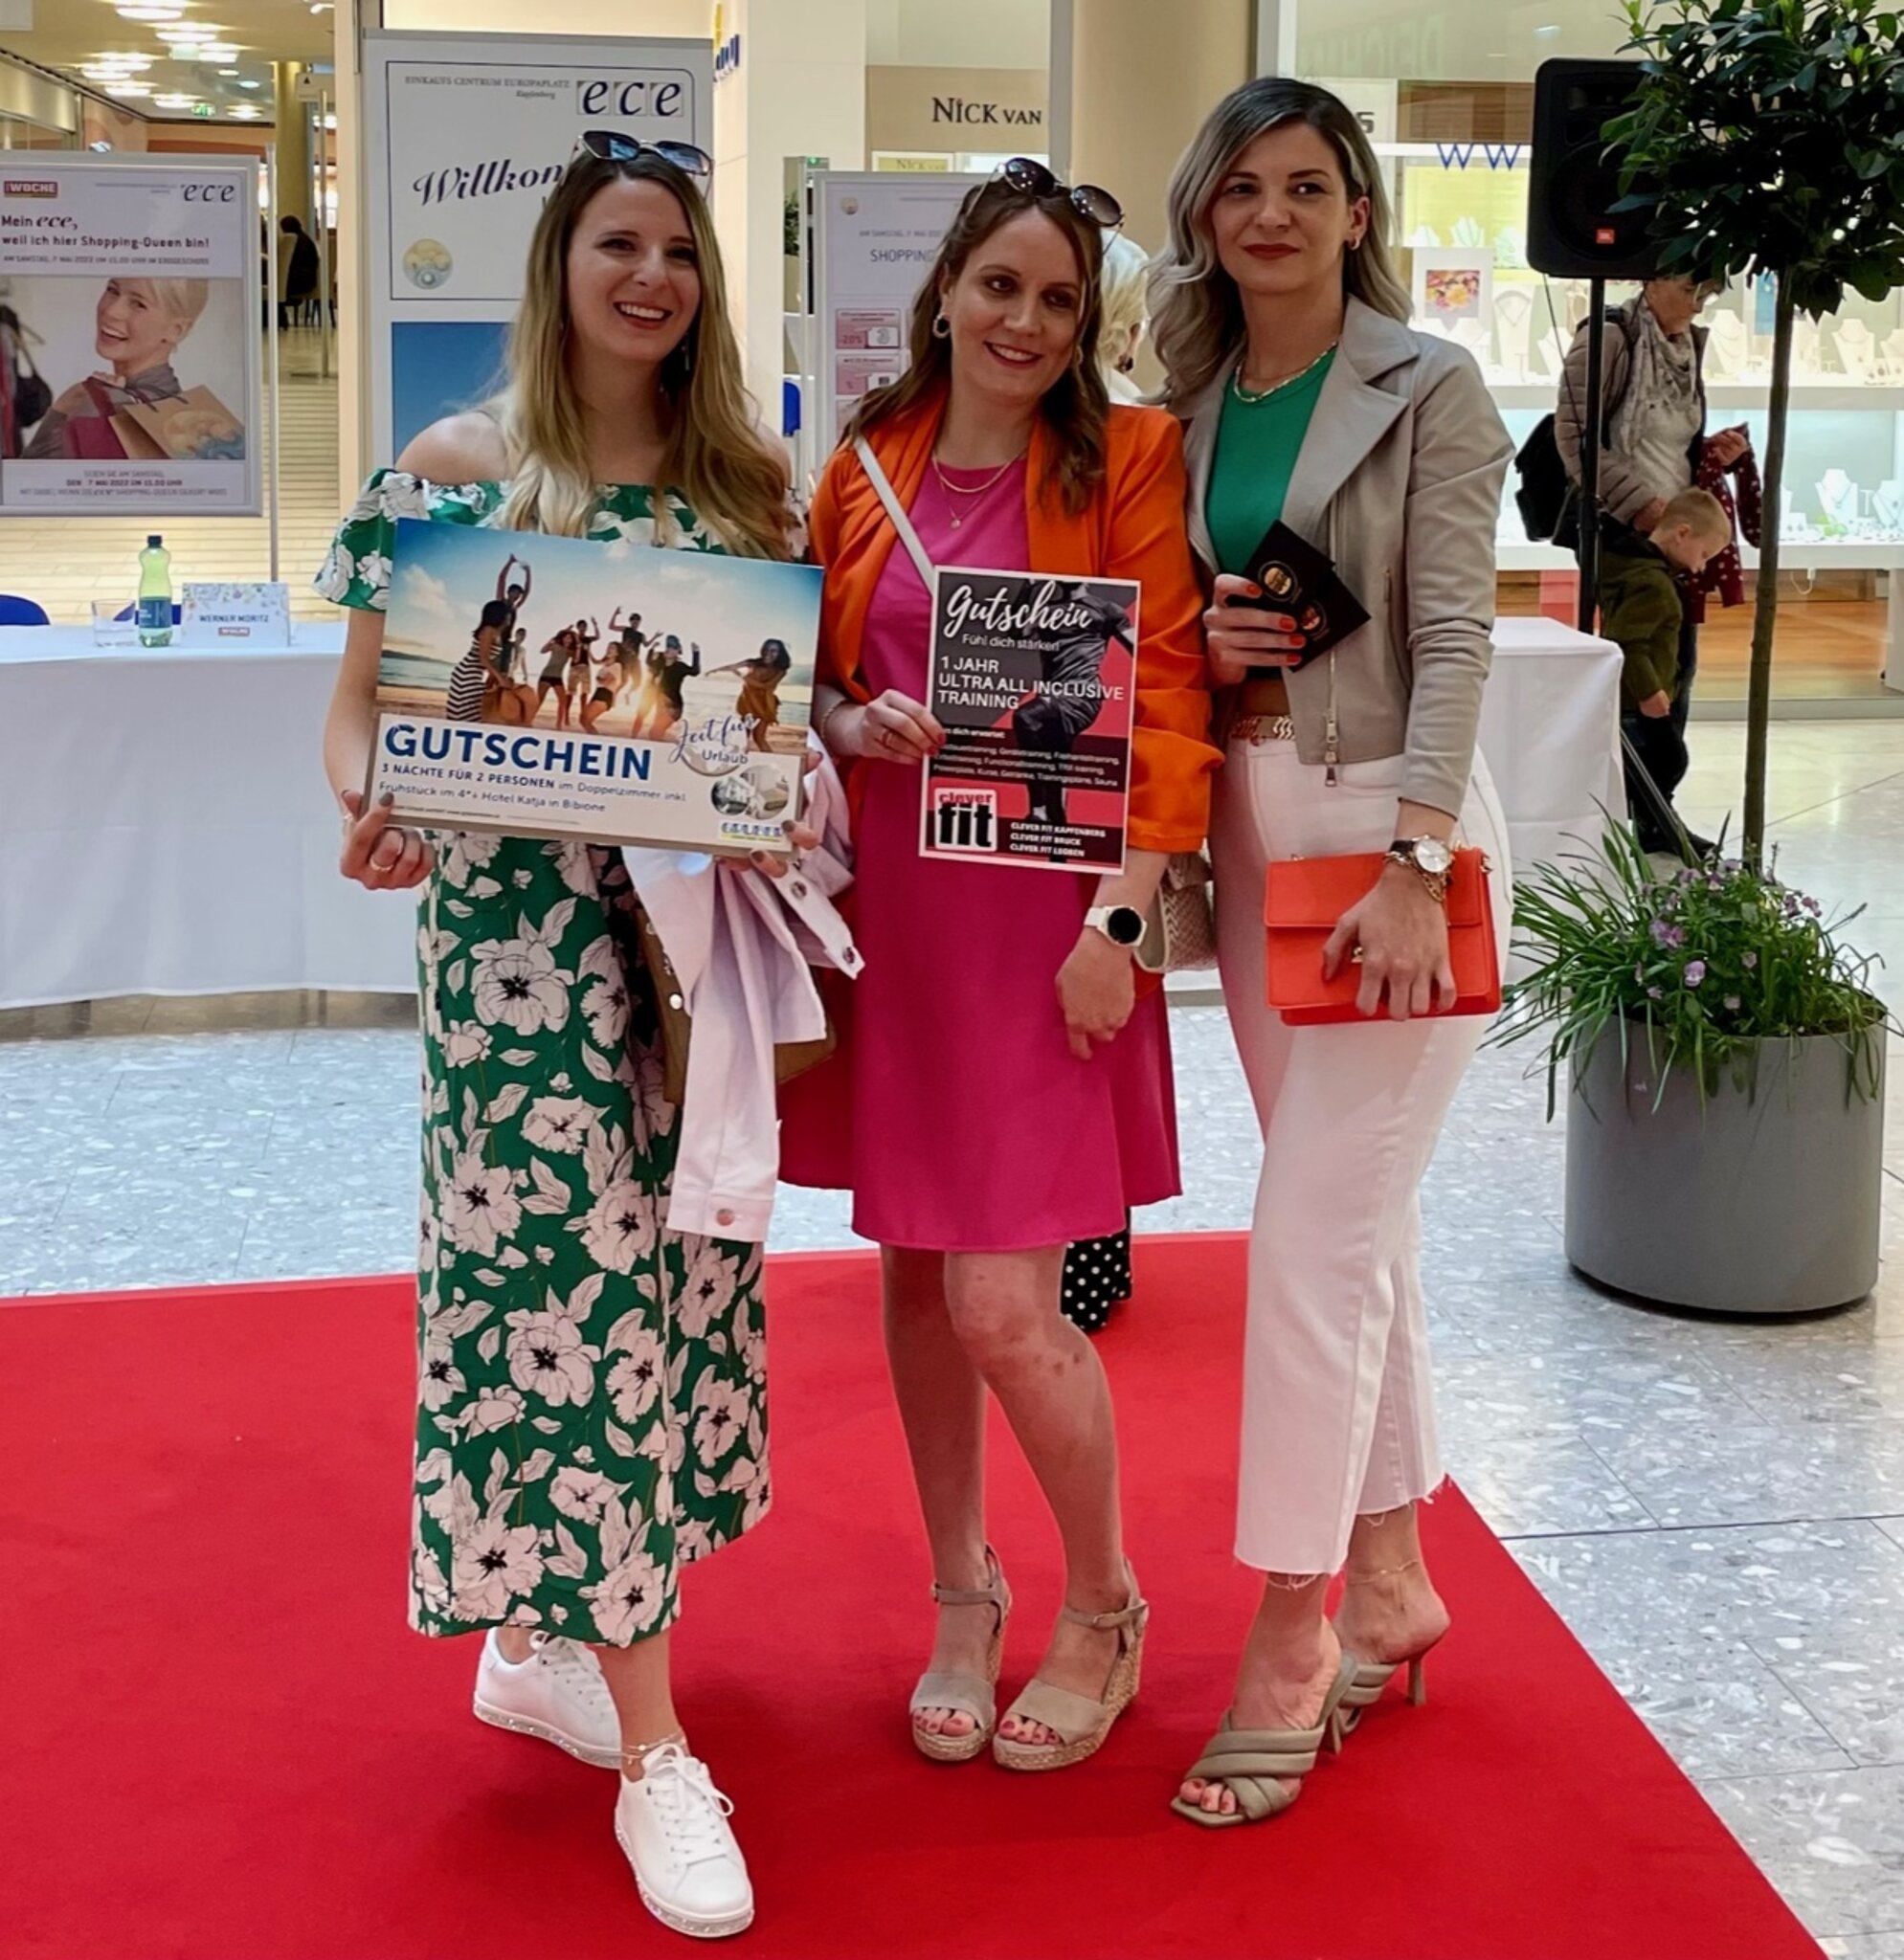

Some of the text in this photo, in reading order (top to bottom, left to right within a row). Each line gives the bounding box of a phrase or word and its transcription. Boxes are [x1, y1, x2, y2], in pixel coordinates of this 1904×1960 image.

[454, 78, 502, 87] CENTRUM
[504, 78, 571, 88] EUROPAPLATZ
[581, 80, 682, 117] ece
[932, 98, 1042, 125] NICK VAN
[181, 183, 235, 203] ece
[1, 215, 34, 227] Mein
[1, 234, 210, 250] weil ich hier Shopping-Queen bin!
[943, 579, 1093, 638] Gutschein
[199, 614, 269, 623] WERNER MORITZ
[989, 635, 1016, 649] dich
[940, 656, 999, 673] 1 JAHR
[938, 672, 1125, 701] ULTRA ALL INCLUSIVE
[937, 689, 1019, 709] TRAINING
[385, 723, 651, 781] GUTSCHEIN
[702, 748, 749, 765] Urlaub
[382, 763, 389, 773] 3
[393, 764, 443, 779] NÄCHTE
[448, 768, 473, 781] FÜR
[477, 773, 483, 782] 2
[488, 773, 555, 789] PERSONEN
[577, 781, 661, 801] Doppelzimmer
[439, 790, 456, 798] im
[482, 791, 514, 804] Hotel
[517, 795, 547, 808] Katja
[549, 799, 559, 809] in
[938, 791, 994, 805] clever
[938, 803, 993, 848] fit
[1010, 821, 1107, 838] CLEVER FIT KAPFENBERG
[1010, 832, 1082, 846] CLEVER FIT BRUCK
[1009, 843, 1040, 854] CLEVER
[1040, 845, 1052, 855] FIT
